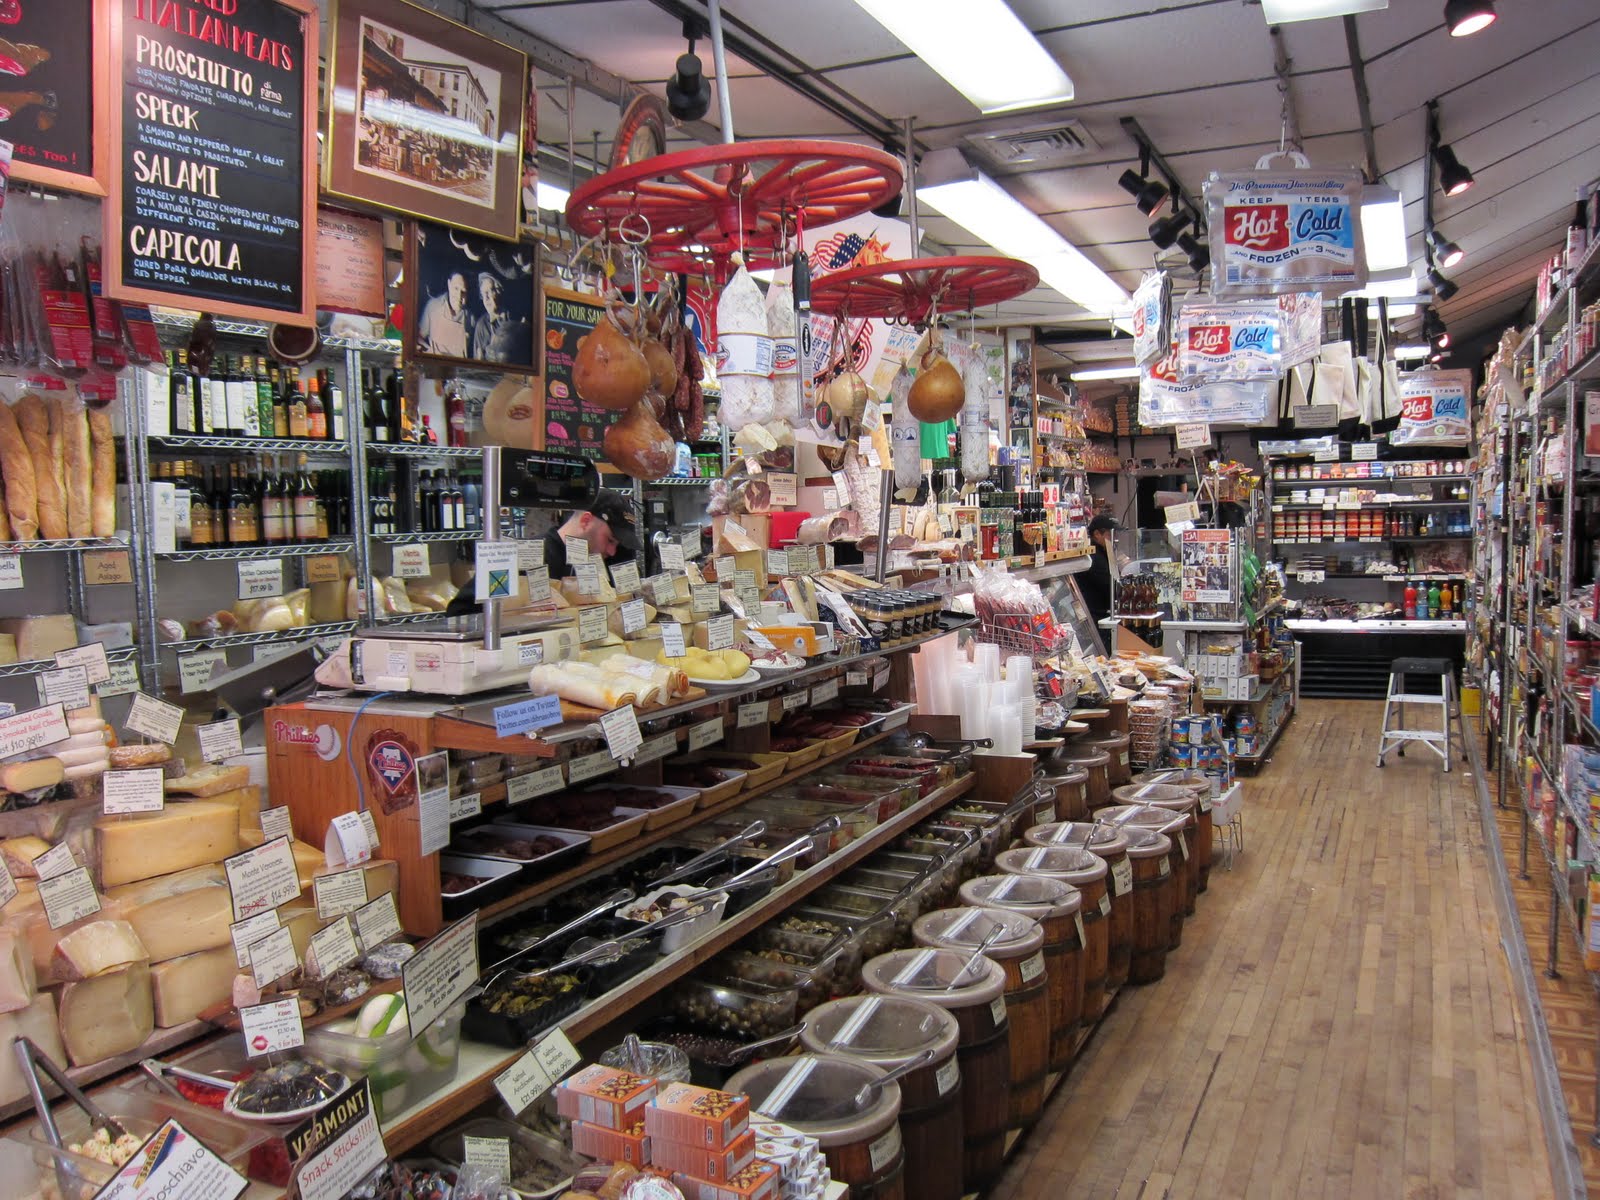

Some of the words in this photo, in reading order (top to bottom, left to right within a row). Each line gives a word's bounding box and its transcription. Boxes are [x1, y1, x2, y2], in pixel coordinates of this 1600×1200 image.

[133, 0, 229, 48] ITALIAN
[232, 25, 294, 71] MEATS
[136, 34, 253, 96] PROSCIUTTO
[157, 82, 178, 96] MANY
[181, 90, 215, 106] OPTIONS.
[216, 91, 237, 104] CURED
[135, 91, 199, 131] SPECK
[138, 123, 144, 132] A
[146, 125, 175, 139] SMOKED
[178, 134, 193, 144] AND
[194, 137, 230, 152] PEPPERED
[255, 153, 260, 161] A
[263, 155, 285, 167] GREAT
[139, 134, 189, 153] ALTERNATIVE
[192, 147, 201, 156] TO
[133, 150, 220, 198] SALAMI
[1229, 182, 1245, 191] The
[1245, 181, 1289, 191] Premium
[136, 186, 175, 201] COARSELY
[179, 195, 190, 205] OR
[192, 198, 217, 211] FINELY
[219, 203, 250, 218] CHOPPED
[251, 212, 270, 222] MEAT
[273, 215, 299, 229] STUFFED
[136, 196, 147, 206] IN
[149, 199, 155, 207] A
[158, 201, 193, 216] NATURAL
[230, 216, 242, 225] WE
[243, 220, 261, 231] HAVE
[263, 224, 285, 236] MANY
[136, 206, 184, 223] DIFFERENT
[188, 217, 219, 231] STYLES.
[1233, 209, 1278, 240] Hot
[1296, 208, 1343, 239] Cold
[130, 225, 242, 271] CAPICOLA
[1249, 247, 1300, 264] FROZEN
[1315, 245, 1324, 253] 3
[134, 258, 161, 270] CURED
[165, 264, 187, 275] PORK
[191, 268, 228, 283] SHOULDER
[231, 276, 251, 286] WITH
[254, 279, 278, 290] BLACK
[281, 284, 292, 293] OR
[134, 268, 149, 278] RED
[154, 272, 190, 285] PEPPER.
[546, 300, 564, 318] FOR
[566, 304, 586, 322] YOUR
[1193, 328, 1224, 349] Hot
[1235, 327, 1268, 348] Cold
[1203, 353, 1237, 363] FROZEN
[1403, 400, 1427, 415] Hot
[1435, 399, 1462, 413] Cold
[97, 561, 116, 571] Aged
[98, 573, 122, 581] Asiago
[521, 649, 537, 658] 2009
[496, 706, 517, 720] Follow
[518, 707, 527, 715] us
[536, 697, 558, 712] Twitter!
[274, 720, 320, 744] Phillies
[242, 867, 259, 879] Monte
[292, 1089, 365, 1158] VERMONT
[140, 1133, 166, 1178] SPAGHETTI
[301, 1154, 333, 1188] Snack
